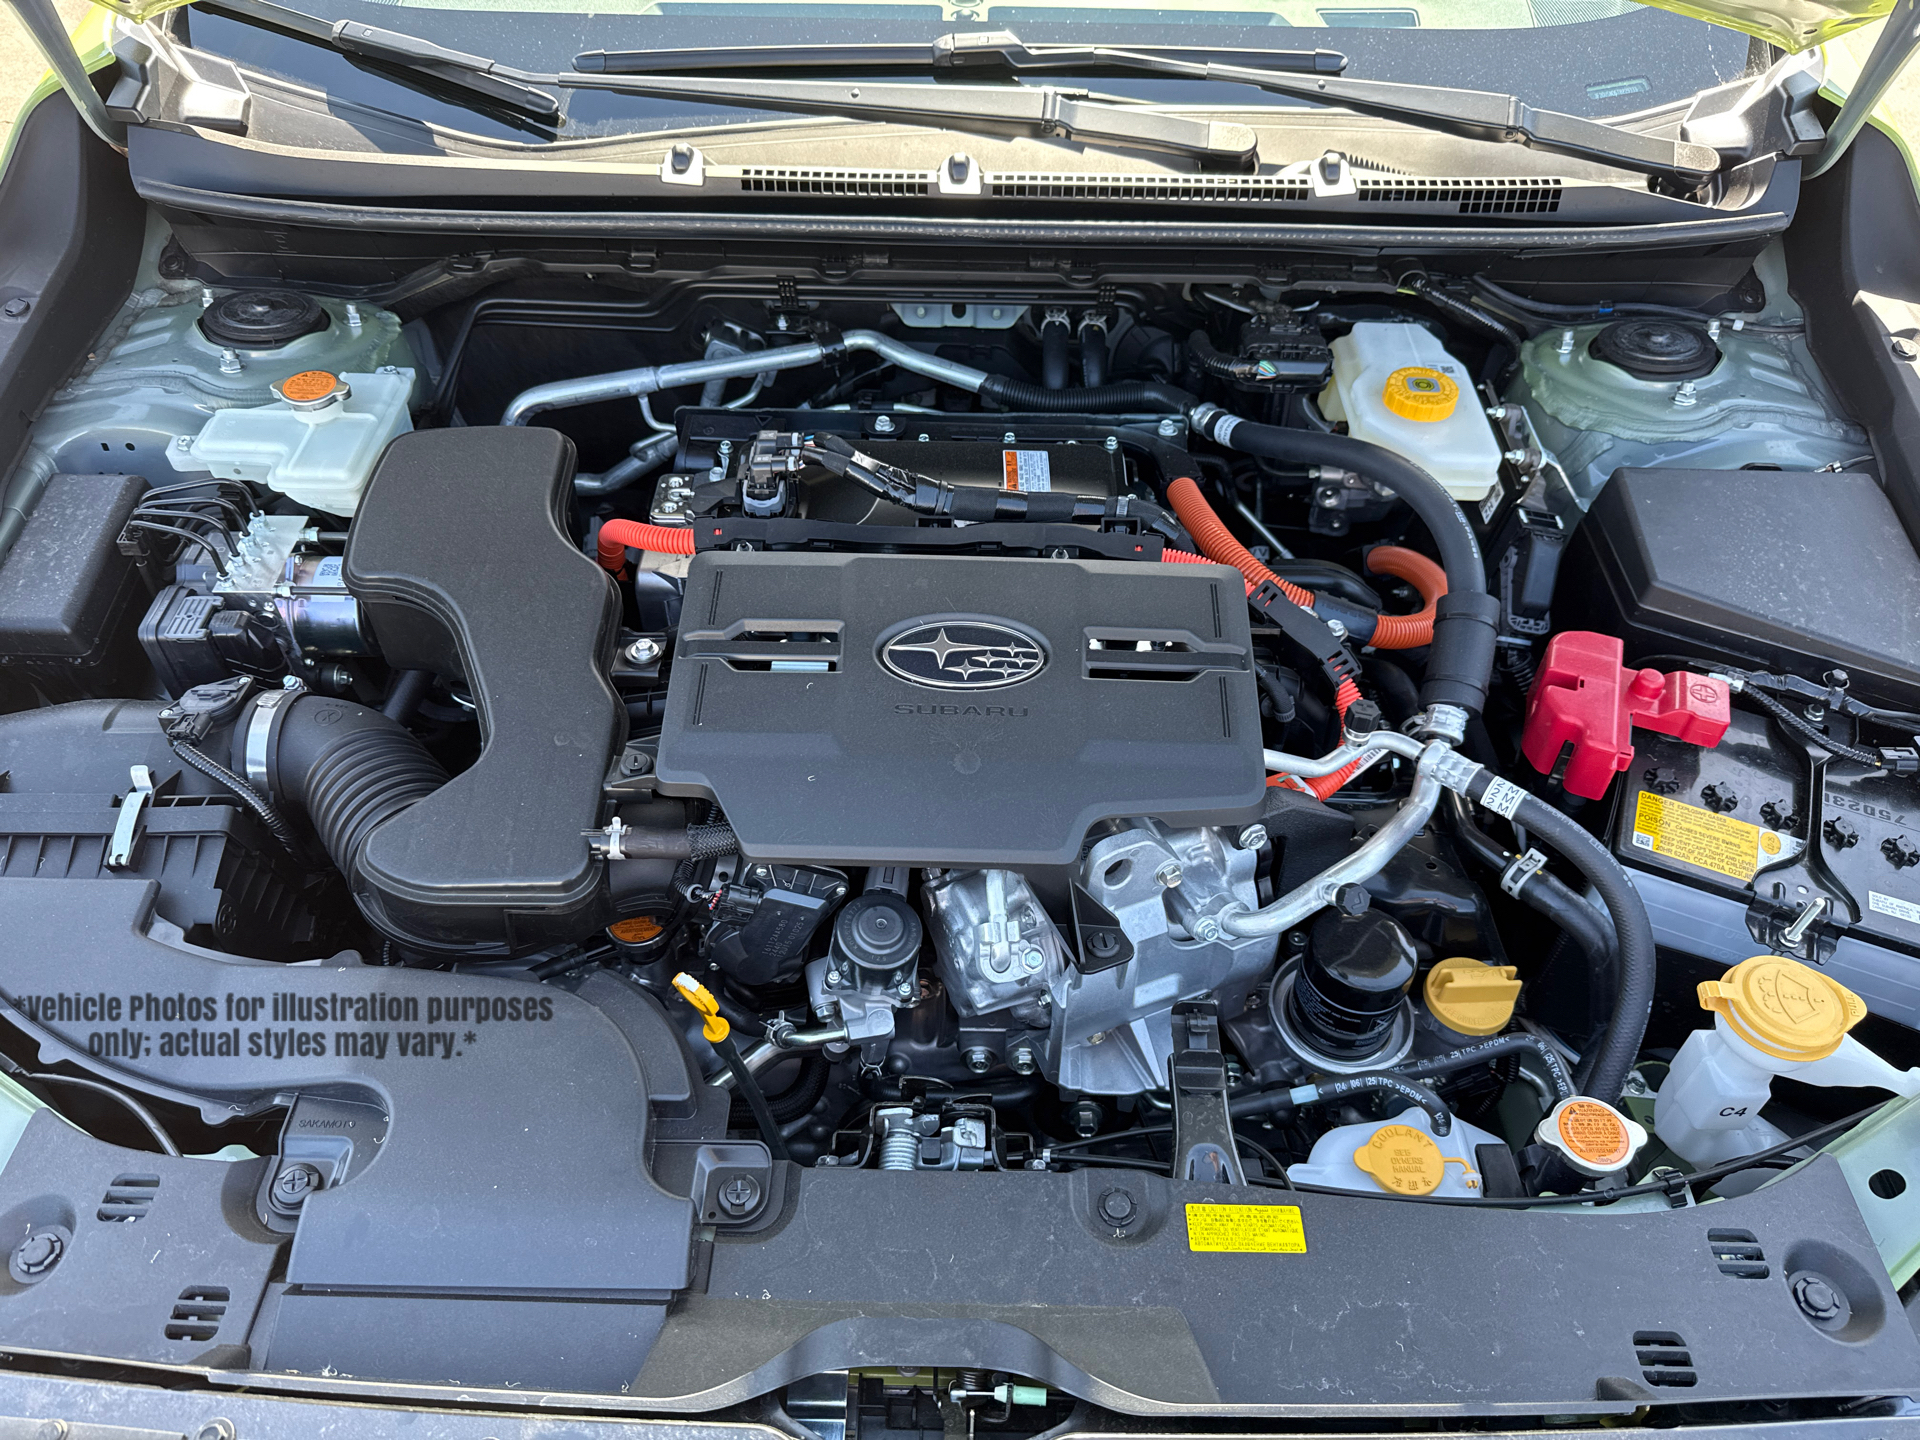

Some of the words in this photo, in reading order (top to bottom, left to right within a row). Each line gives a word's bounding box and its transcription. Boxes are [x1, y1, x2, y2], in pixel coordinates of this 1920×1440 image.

[893, 703, 1029, 717] SUBARU
[1491, 787, 1501, 798] 2
[1502, 792, 1514, 805] M
[1496, 780, 1506, 788] 2
[1507, 785, 1520, 795] M
[1487, 797, 1496, 806] 2
[1497, 802, 1509, 814] M
[1641, 793, 1675, 808] DANGER
[1677, 805, 1707, 817] EXPLOSIVE
[1708, 814, 1727, 823] GASES
[1638, 813, 1671, 827] POISON
[1675, 825, 1698, 835] CAUSES
[1698, 832, 1721, 842] SEVERE
[1655, 845, 1674, 855] 20HR
[1674, 850, 1692, 860] 62Ah
[1693, 856, 1709, 866] CCA
[1660, 834, 1675, 842] KEEP
[1675, 839, 1691, 847] VENT
[1691, 844, 1707, 853] CAPS
[1708, 849, 1725, 858] TIGHT
[1737, 859, 1756, 868] LEVEL
[1660, 840, 1674, 848] KEEP
[1696, 851, 1715, 860] REACH
[1726, 860, 1755, 873] CHILDREN
[1462, 1046, 1477, 1056] TPC
[1479, 1036, 1510, 1050] >EPDM<
[1550, 1063, 1562, 1078] TPC
[1378, 1076, 1393, 1087] TPC
[1395, 1083, 1428, 1104] >EPDM<
[1719, 1107, 1748, 1117] C4
[299, 1119, 356, 1128] SAKAMOTO
[1372, 1127, 1434, 1149] COOLANT
